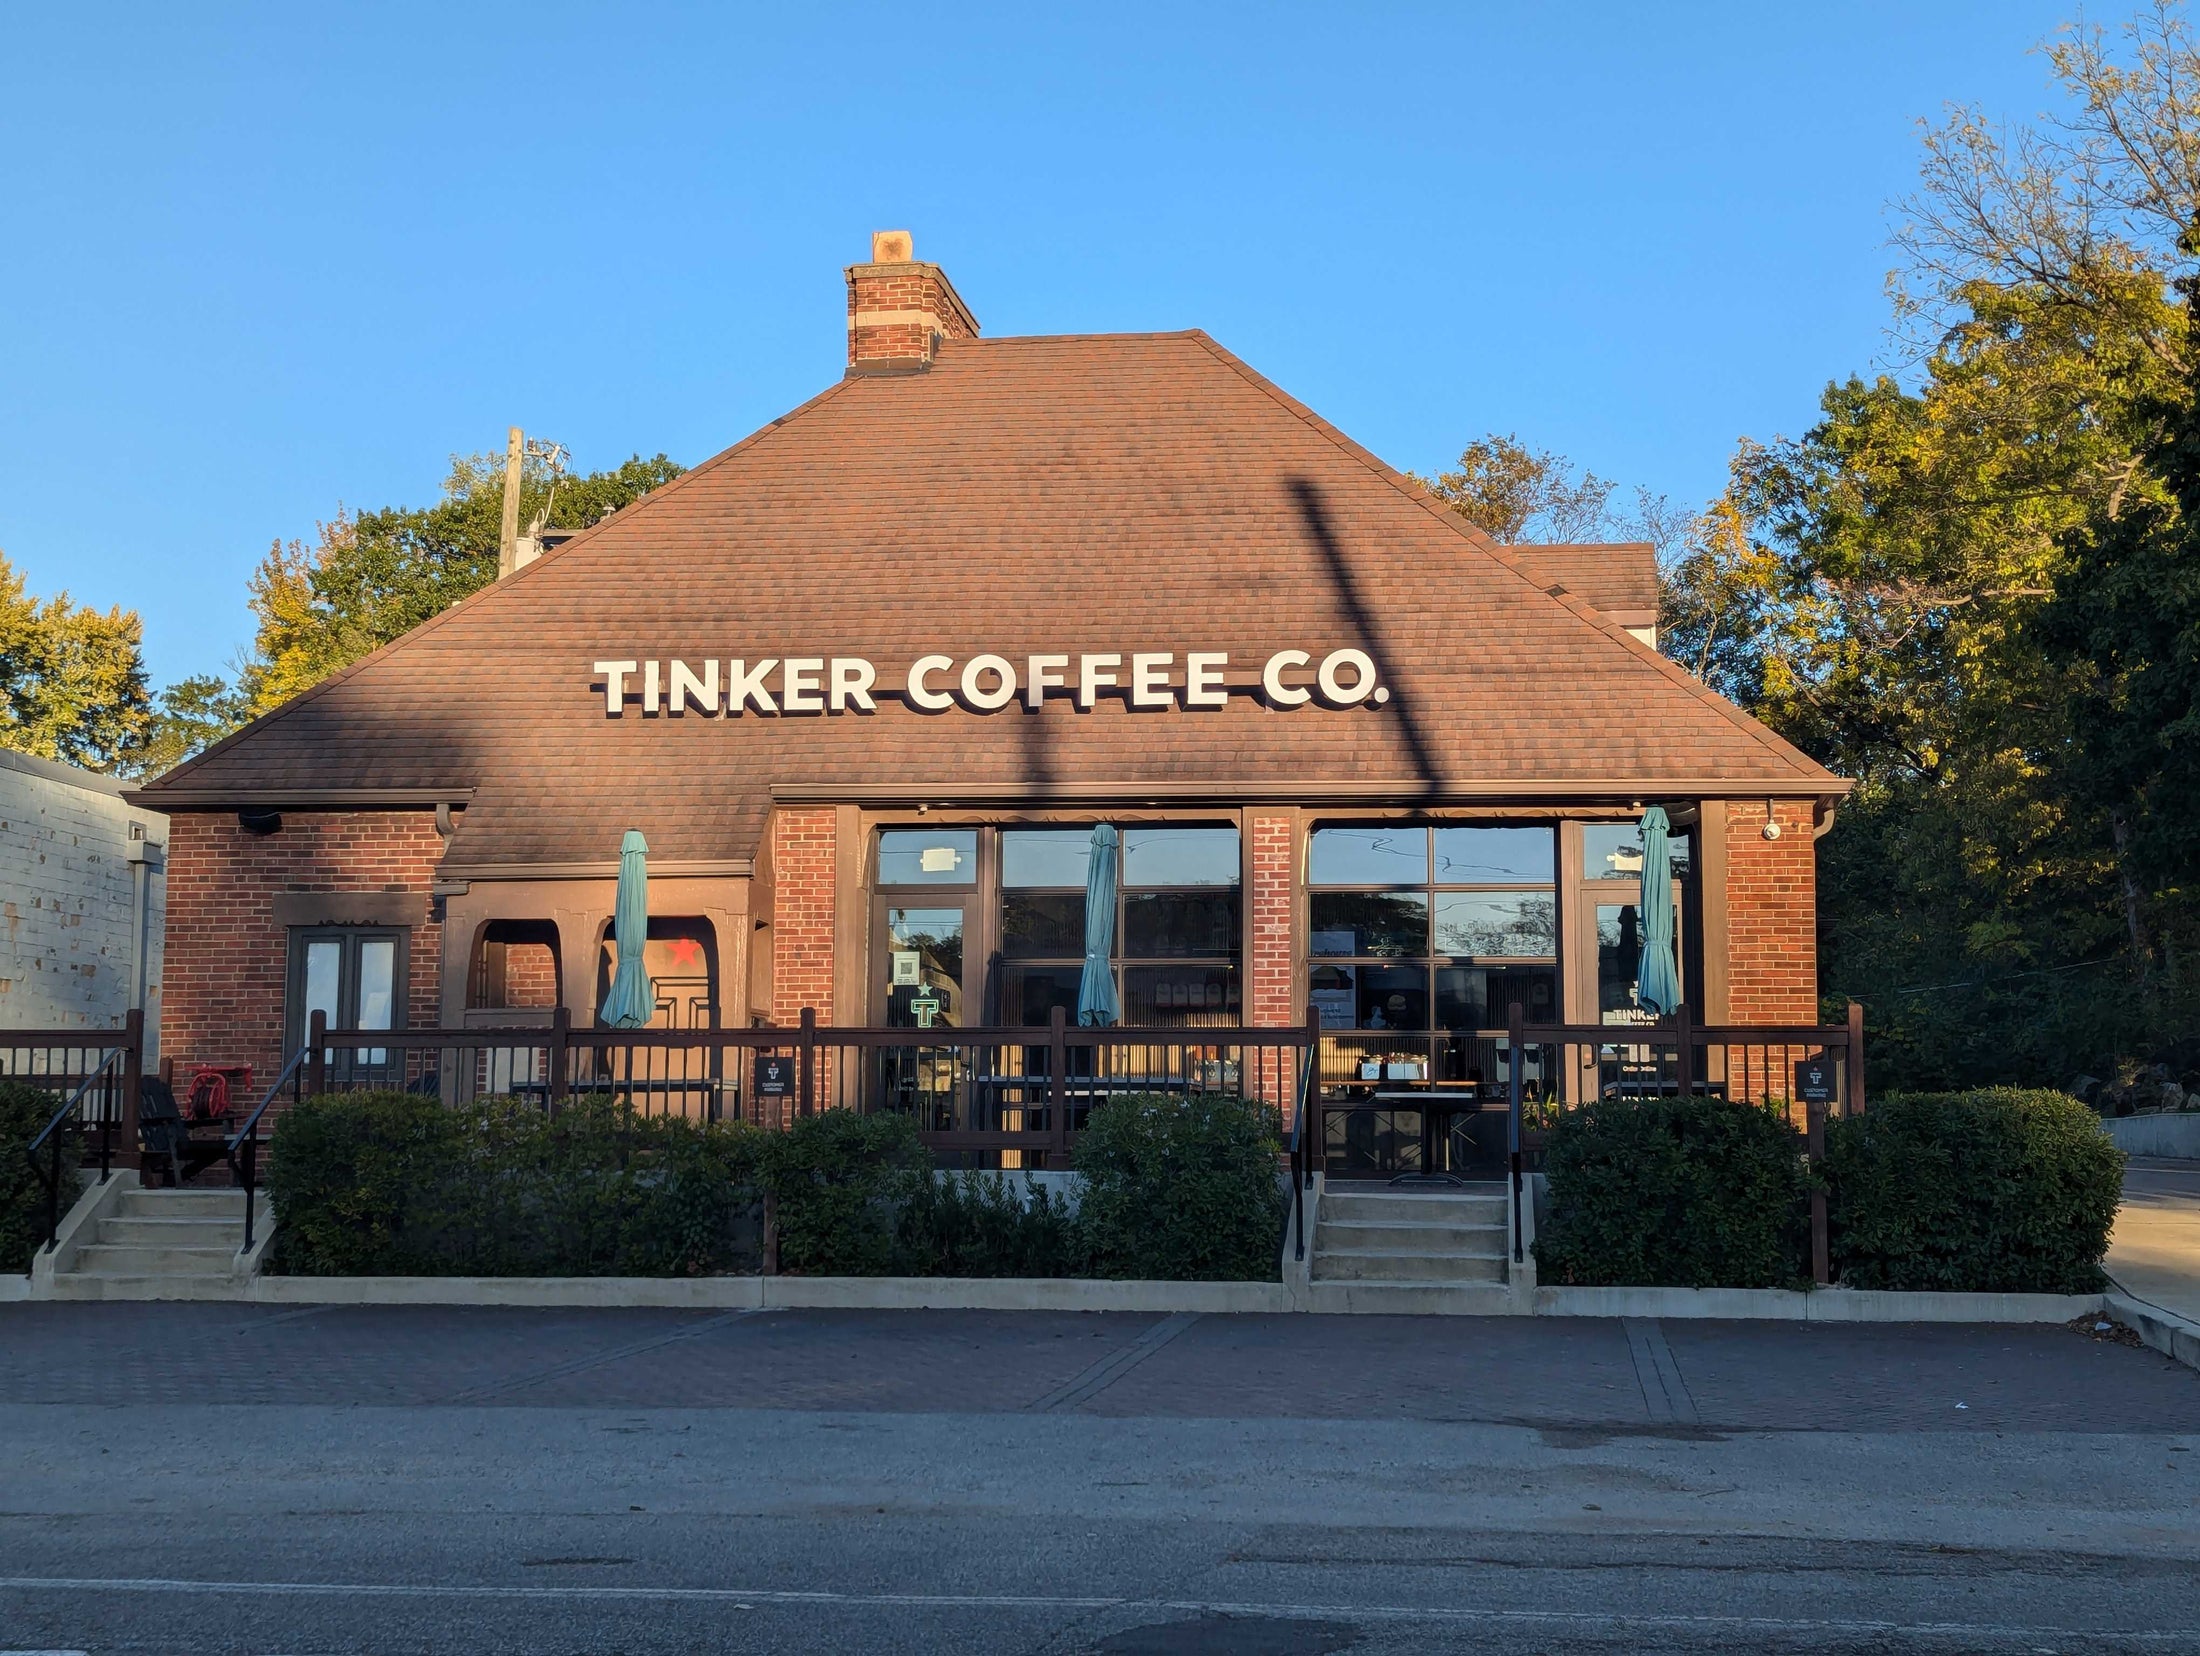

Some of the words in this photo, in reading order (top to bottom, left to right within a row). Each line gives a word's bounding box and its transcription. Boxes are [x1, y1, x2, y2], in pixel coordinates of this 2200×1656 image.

[594, 658, 878, 713] TINKER
[907, 652, 1229, 710] COFFEE
[1263, 648, 1390, 705] CO.
